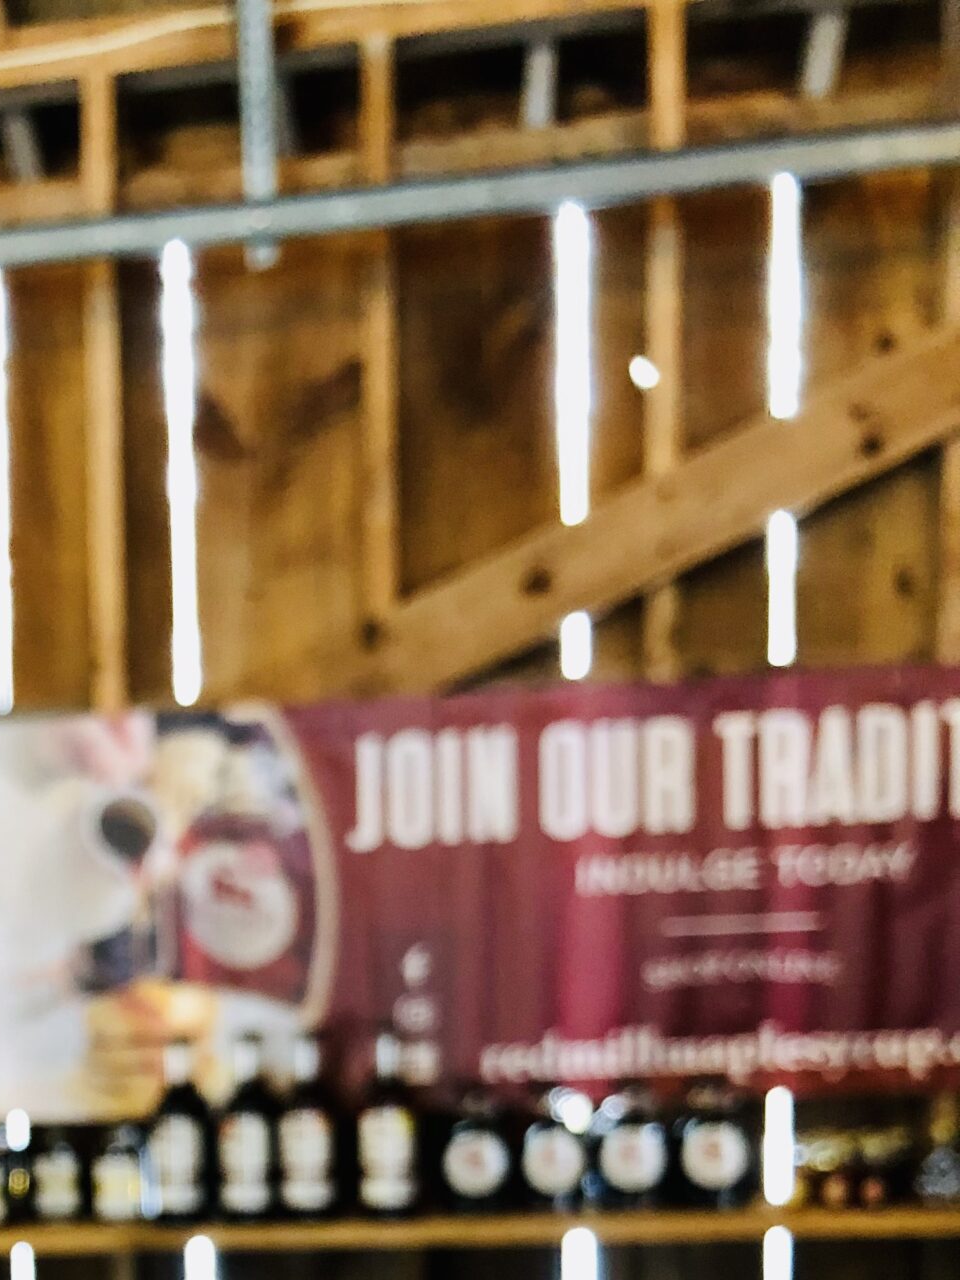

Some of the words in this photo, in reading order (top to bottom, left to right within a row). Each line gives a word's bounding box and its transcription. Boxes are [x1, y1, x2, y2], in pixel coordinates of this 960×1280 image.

[346, 724, 519, 854] JOIN
[540, 714, 696, 842] OUR
[771, 839, 918, 888] TODAY
